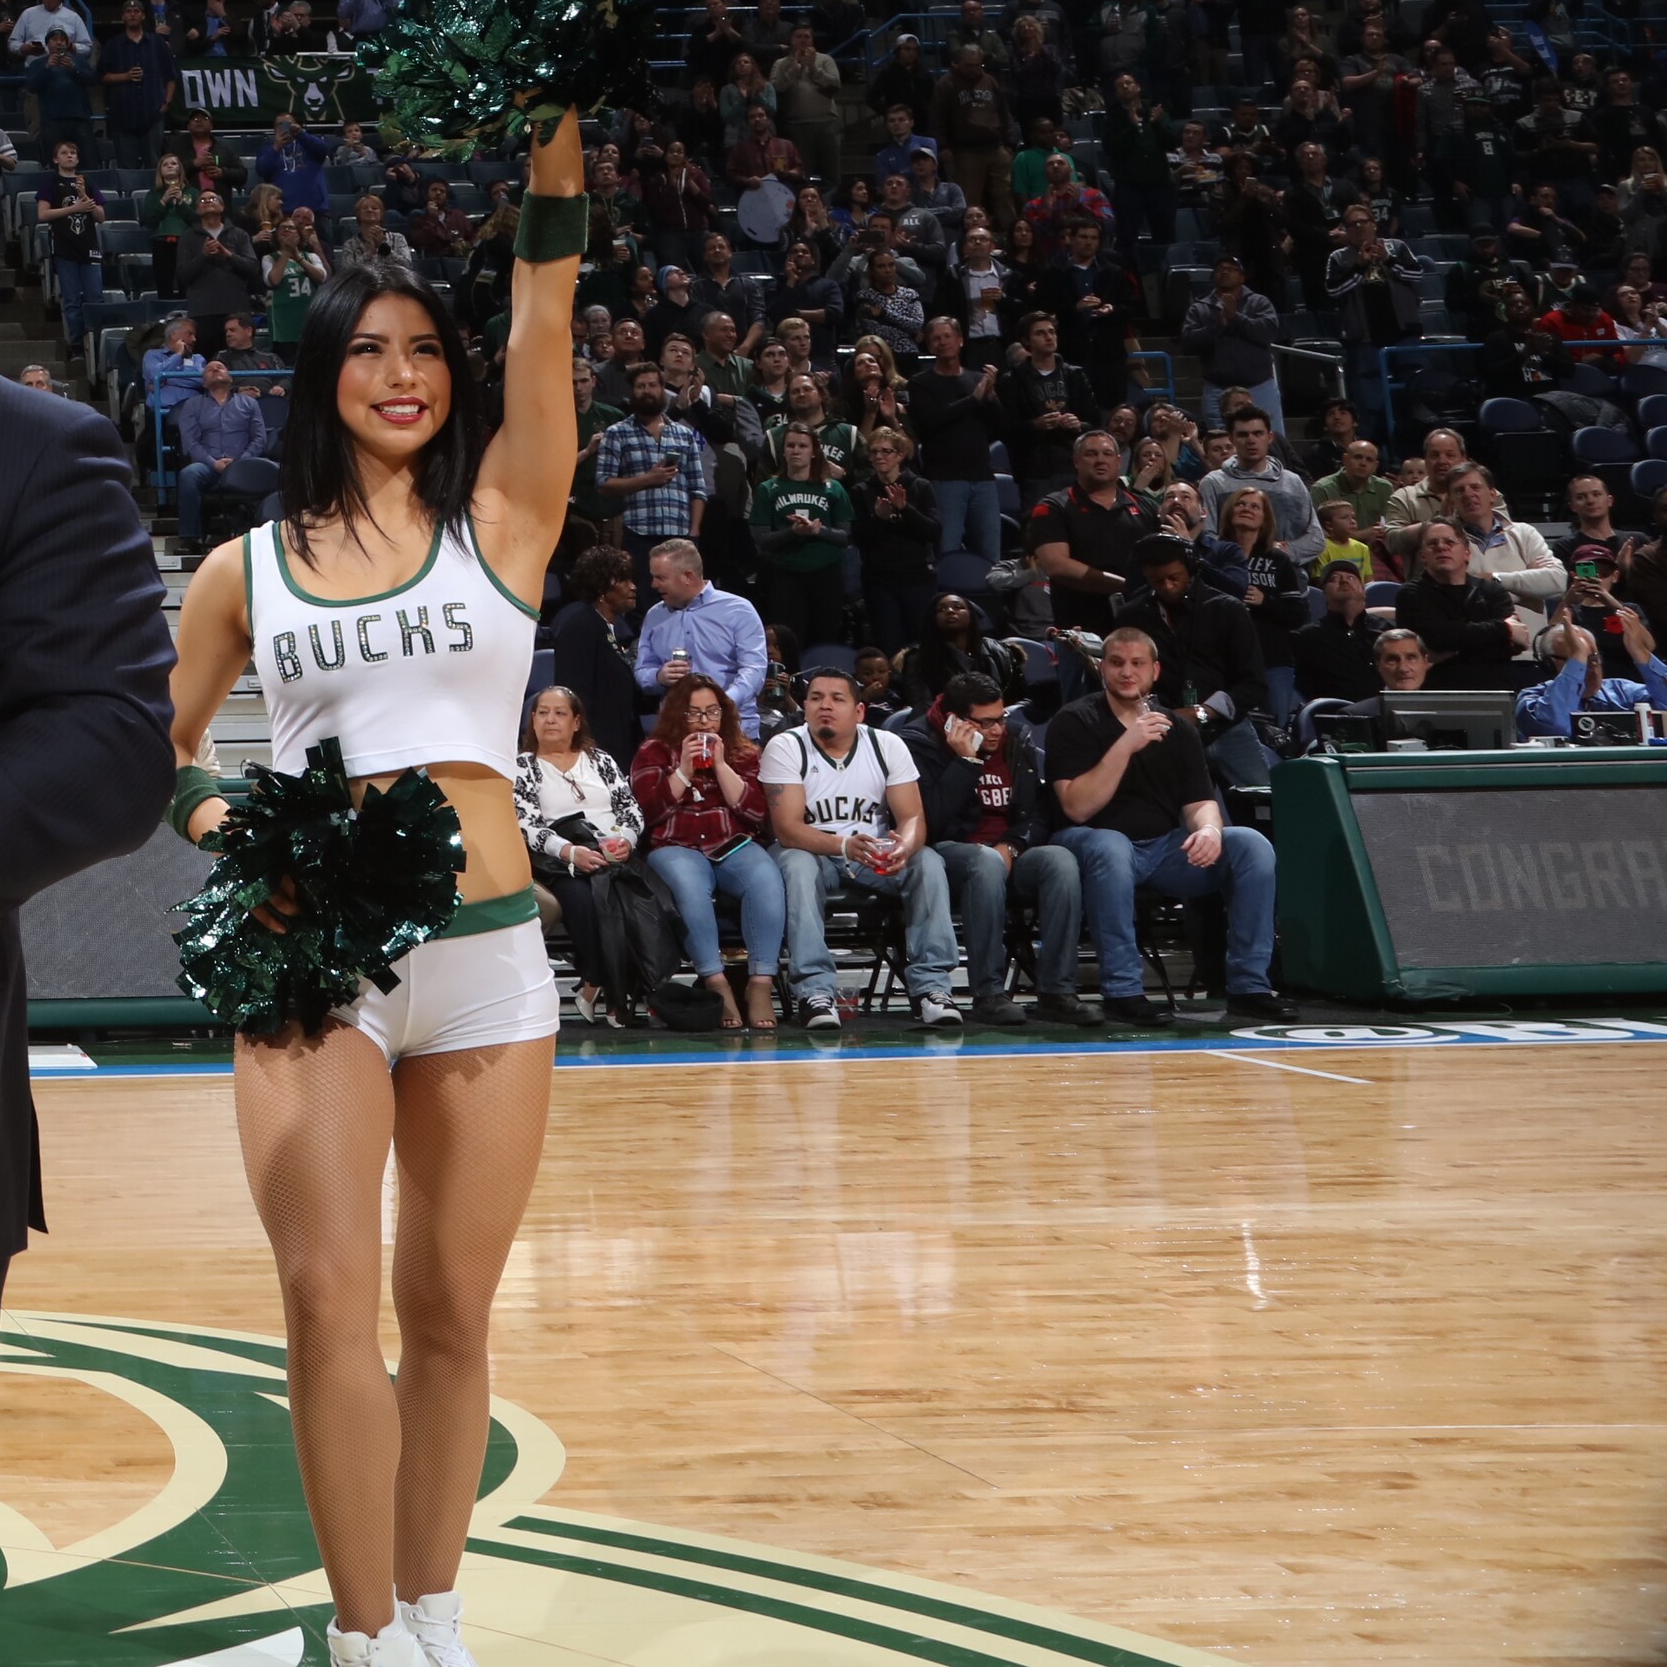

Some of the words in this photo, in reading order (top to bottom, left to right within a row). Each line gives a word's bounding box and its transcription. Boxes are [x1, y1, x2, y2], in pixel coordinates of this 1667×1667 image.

[180, 68, 259, 108] OWN
[288, 277, 312, 298] 34
[271, 601, 476, 684] BUCKS
